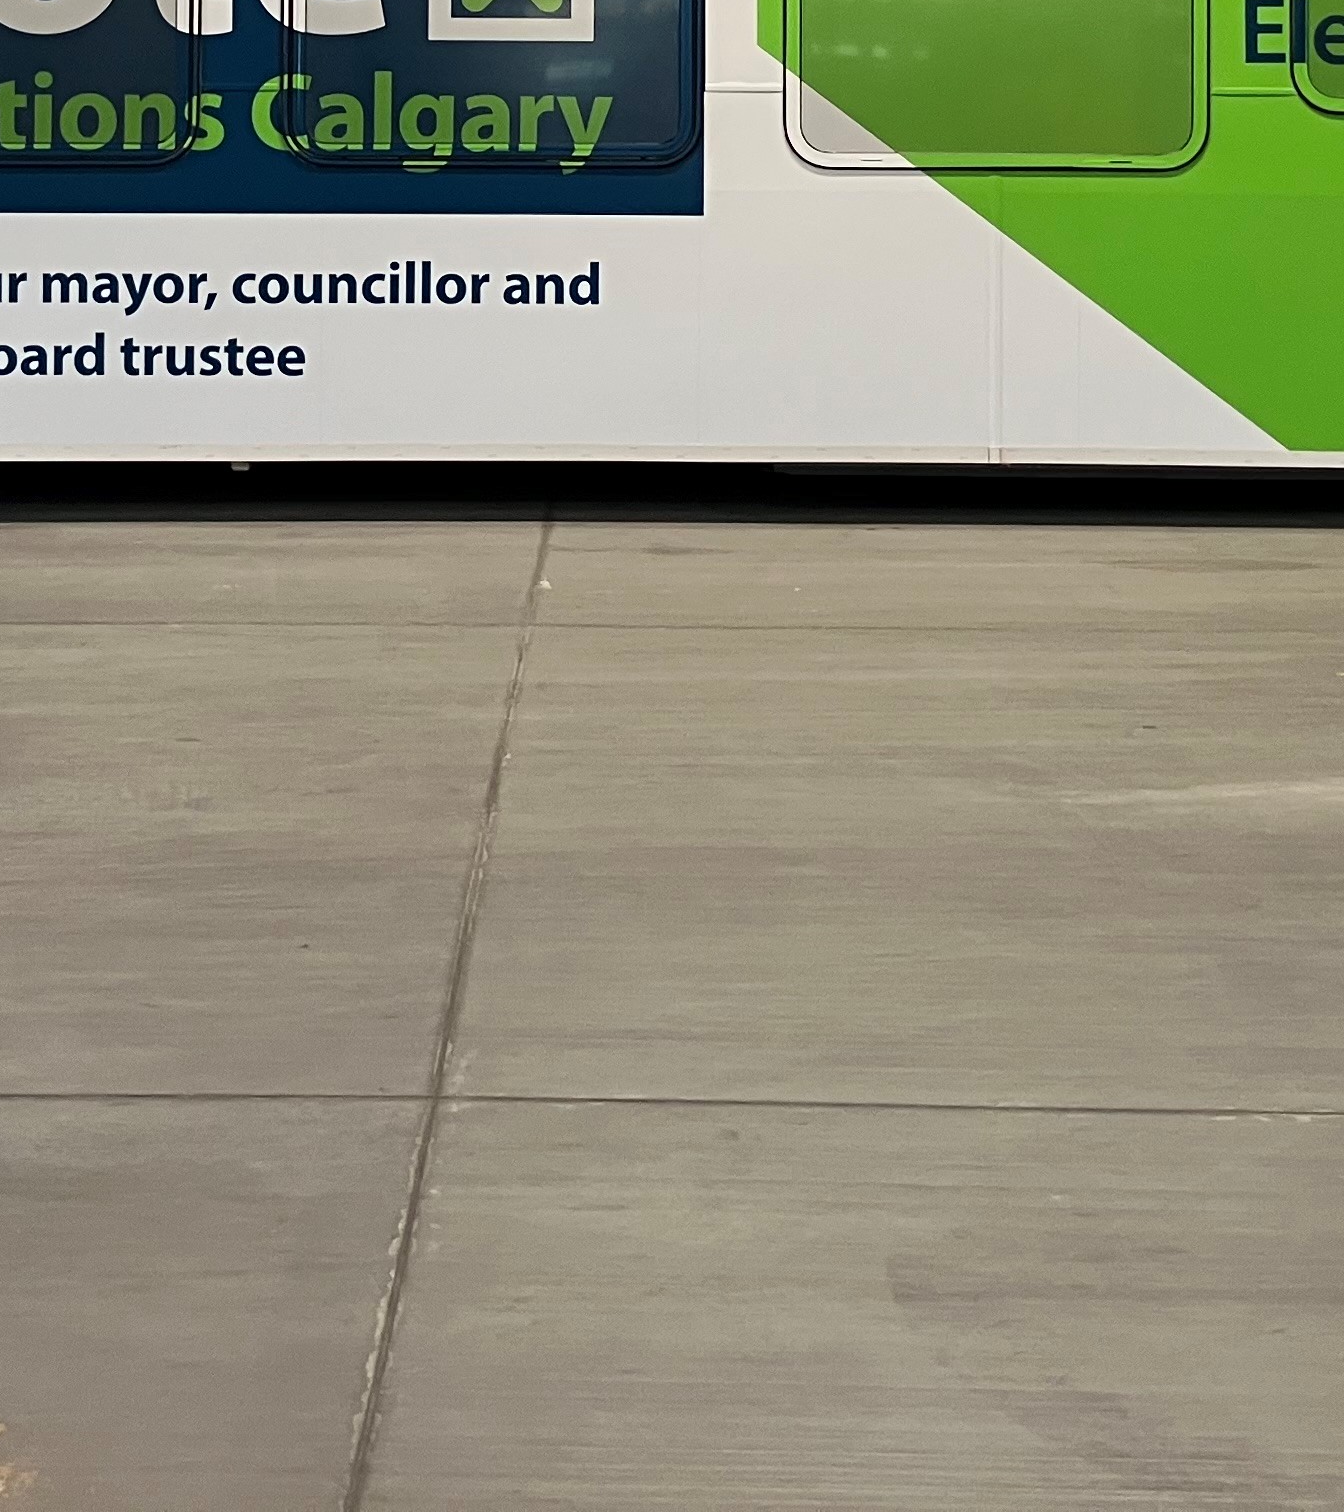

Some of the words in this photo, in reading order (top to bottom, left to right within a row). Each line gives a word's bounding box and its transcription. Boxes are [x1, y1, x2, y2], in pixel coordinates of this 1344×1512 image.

[250, 70, 613, 175] Calgary
[42, 272, 218, 316] mayor,
[232, 260, 490, 305] councillor
[503, 261, 600, 306] and
[119, 337, 306, 377] trustee
